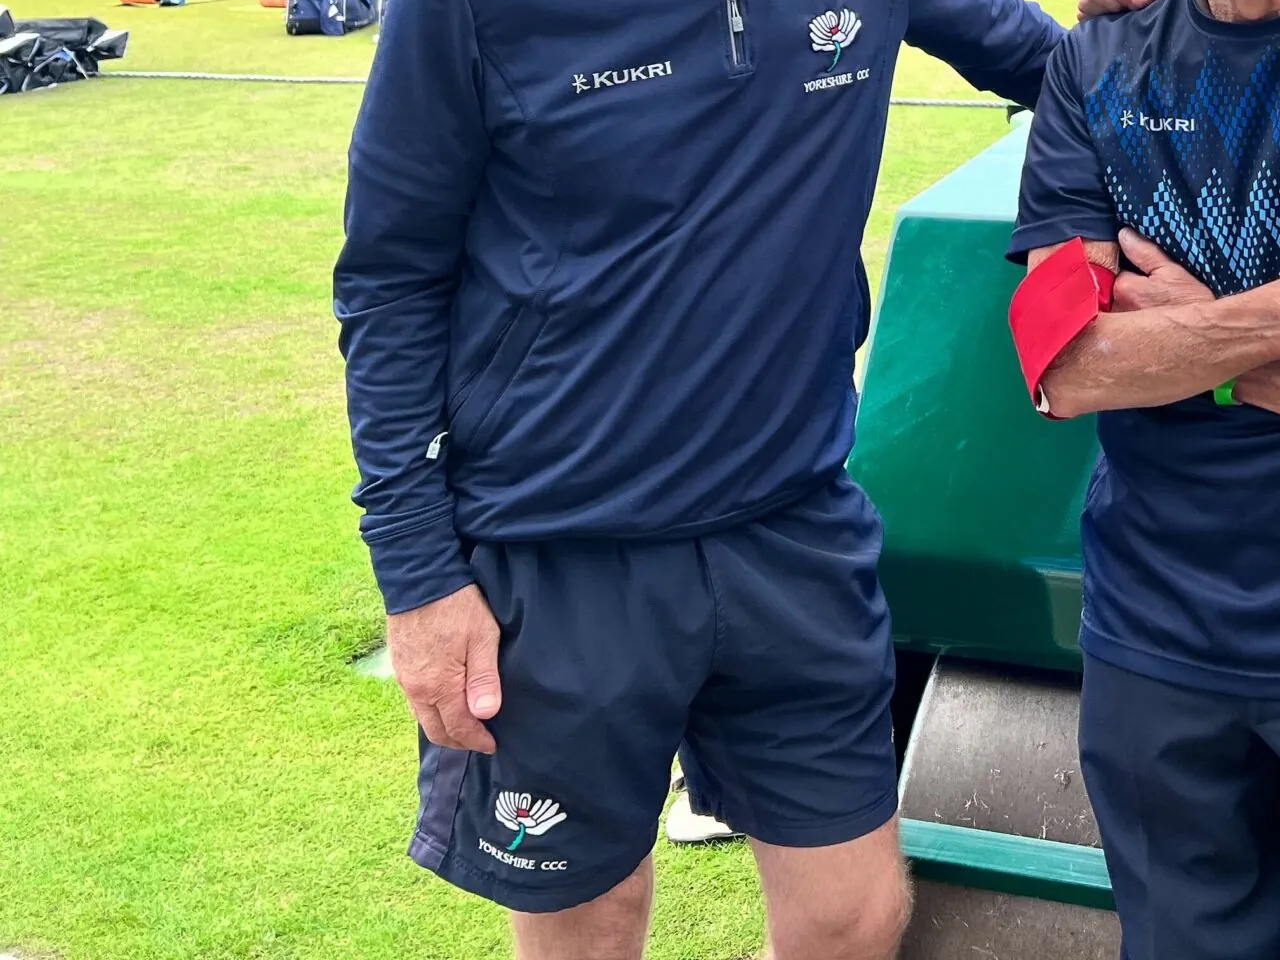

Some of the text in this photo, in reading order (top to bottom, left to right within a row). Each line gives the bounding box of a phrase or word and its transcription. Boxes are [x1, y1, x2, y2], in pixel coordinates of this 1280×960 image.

[593, 60, 673, 89] KUKRI
[803, 68, 870, 93] YORKSHIRE CCC
[1139, 112, 1195, 132] KUKRI
[478, 838, 568, 870] YORKSHIRE CCC
